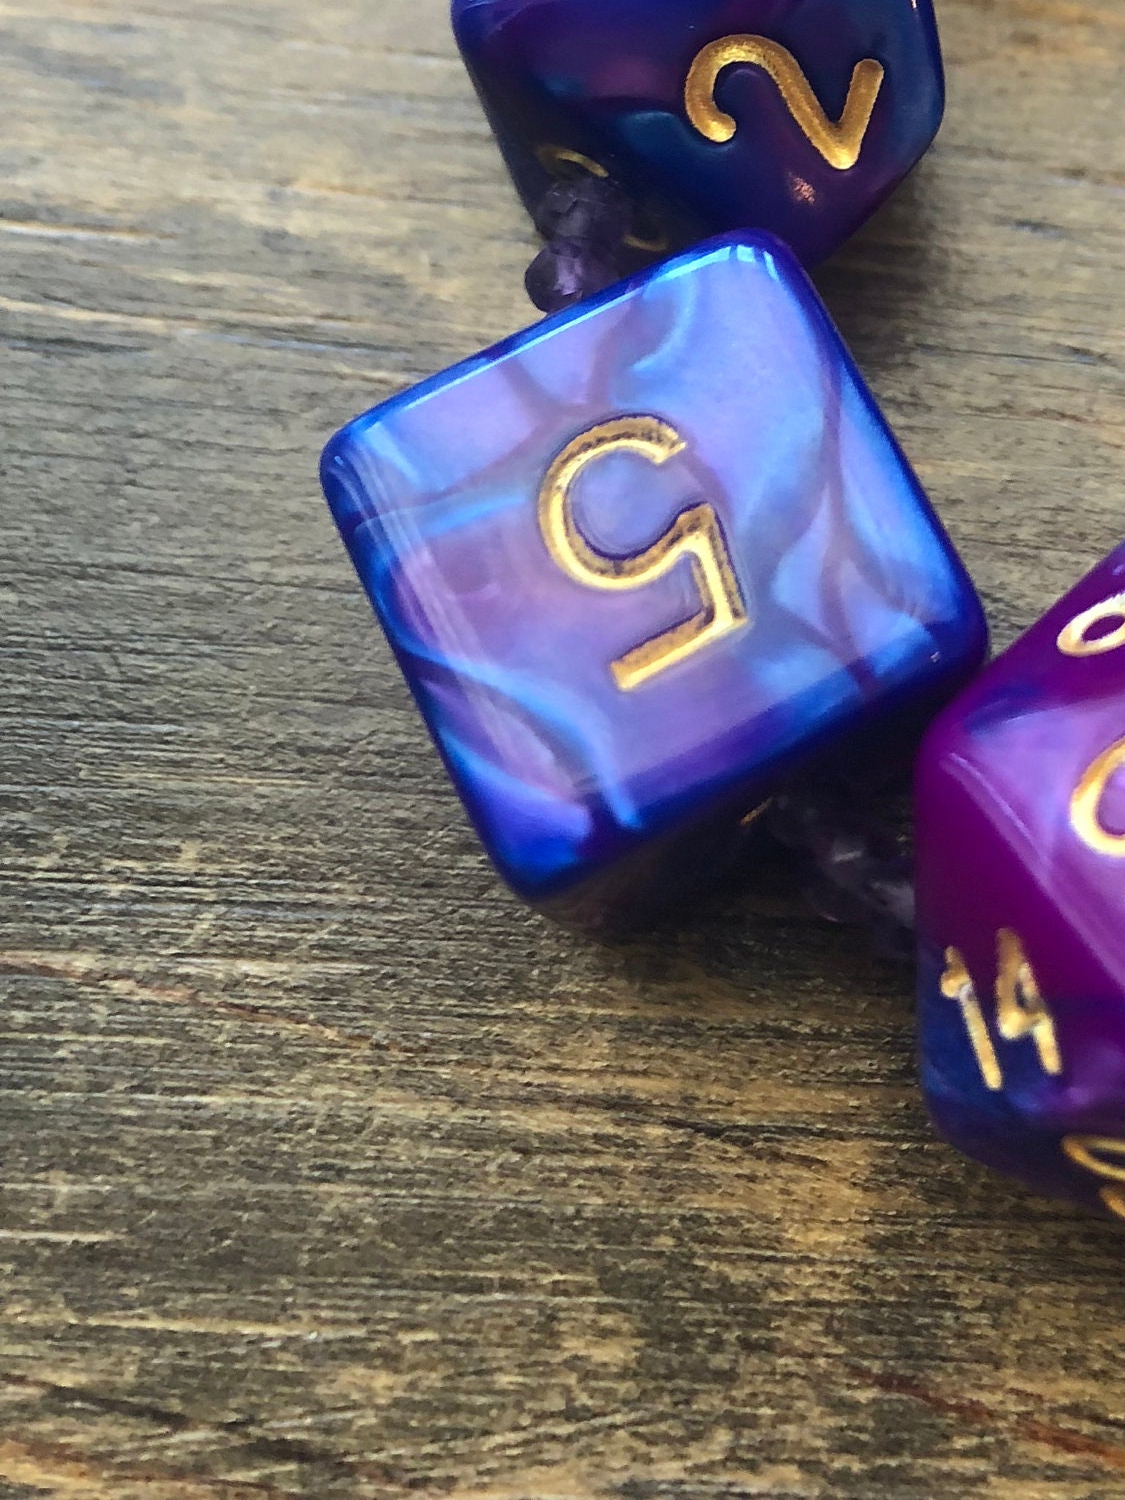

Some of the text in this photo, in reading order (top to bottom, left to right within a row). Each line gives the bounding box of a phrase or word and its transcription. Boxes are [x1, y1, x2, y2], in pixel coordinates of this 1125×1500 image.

[684, 33, 885, 171] 2
[538, 411, 750, 694] 5
[940, 927, 1062, 1091] 14
